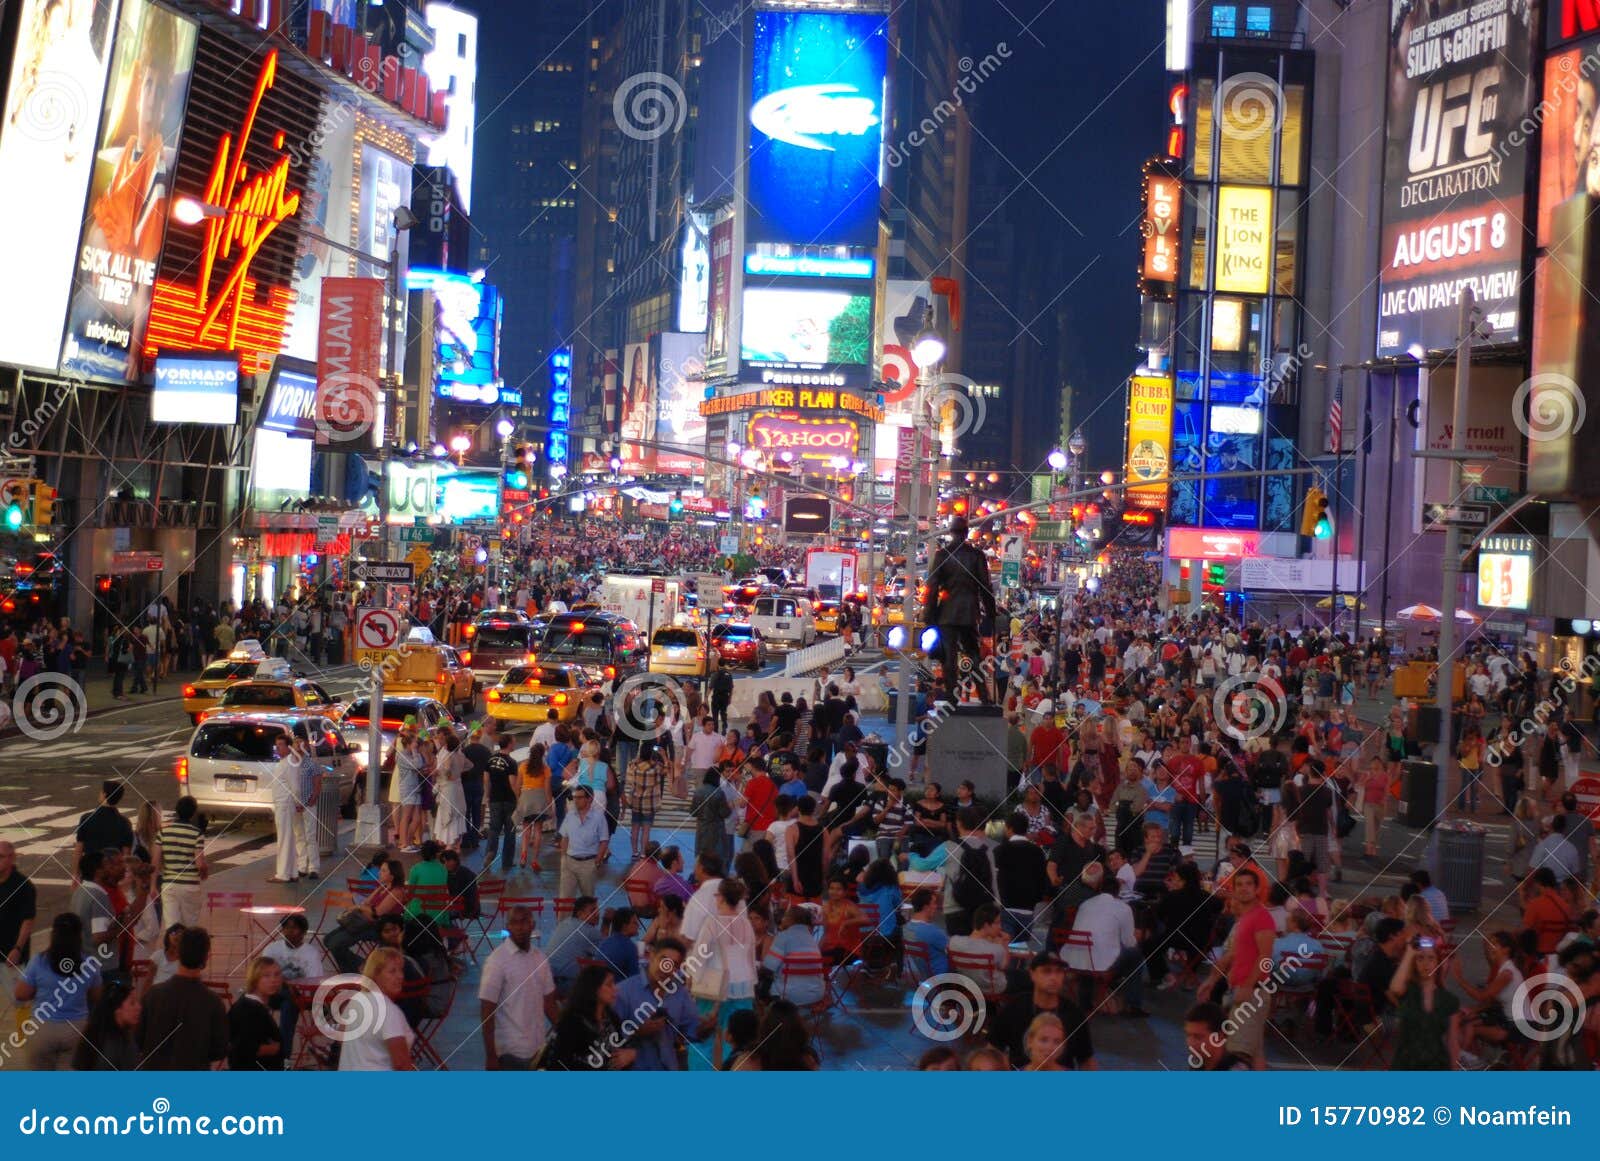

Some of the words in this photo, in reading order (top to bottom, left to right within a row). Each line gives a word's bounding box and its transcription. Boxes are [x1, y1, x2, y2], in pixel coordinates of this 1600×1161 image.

[1407, 36, 1442, 79] SILVA
[1453, 13, 1508, 62] GRIFFIN
[1408, 66, 1501, 173] UFC
[1400, 162, 1501, 208] DECLARATION
[1230, 207, 1259, 222] THE
[1224, 225, 1263, 249] LION
[1393, 216, 1487, 268] AUGUST
[1490, 213, 1507, 249] 8
[80, 246, 112, 275] SICK
[110, 253, 133, 279] ALL
[134, 259, 156, 286] THE
[1222, 254, 1263, 277] KING
[98, 276, 133, 306] TIME?
[1381, 292, 1406, 317] LIVE
[1407, 287, 1428, 312] ON
[86, 320, 130, 348] info4pi.org
[156, 367, 237, 382] VORNADO
[763, 370, 845, 386] Panasonic
[799, 390, 834, 408] PLAN
[1133, 383, 1170, 400] BUBBA
[1135, 400, 1168, 416] GUMP
[755, 427, 852, 448] YAHOO!
[1461, 511, 1481, 520] WAY
[1480, 538, 1532, 551] MARQUIS
[358, 566, 377, 576] ONE
[385, 566, 406, 577] WAY
[364, 651, 391, 662] NEW
